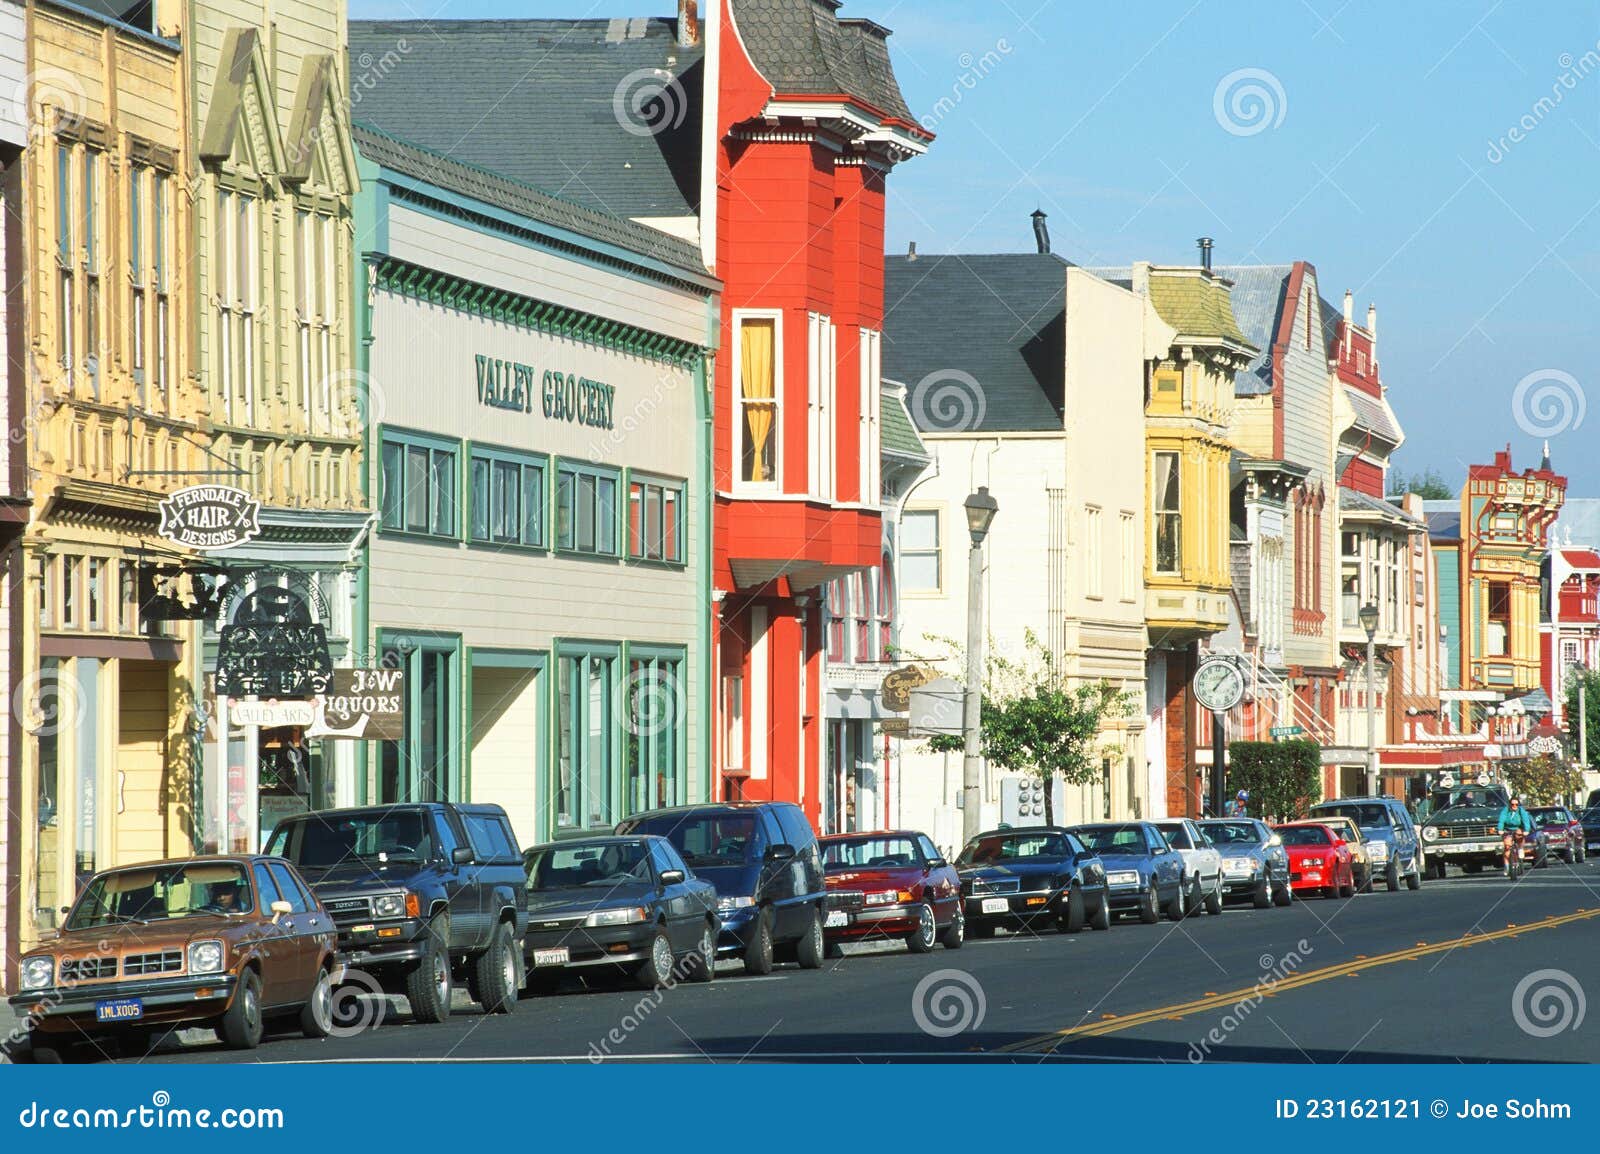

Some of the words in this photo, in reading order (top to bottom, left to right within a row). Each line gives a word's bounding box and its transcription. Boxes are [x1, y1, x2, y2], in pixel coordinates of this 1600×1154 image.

[475, 354, 534, 413] VALLEY
[542, 369, 616, 430] GROCERY
[175, 488, 243, 509] FERNDALE
[187, 506, 231, 528] HAIR
[180, 528, 237, 545] DESIGNS
[351, 670, 403, 693] J&W
[236, 708, 274, 722] VALLEY
[282, 706, 311, 722] ARTS
[100, 1004, 140, 1019] 1MLX005
